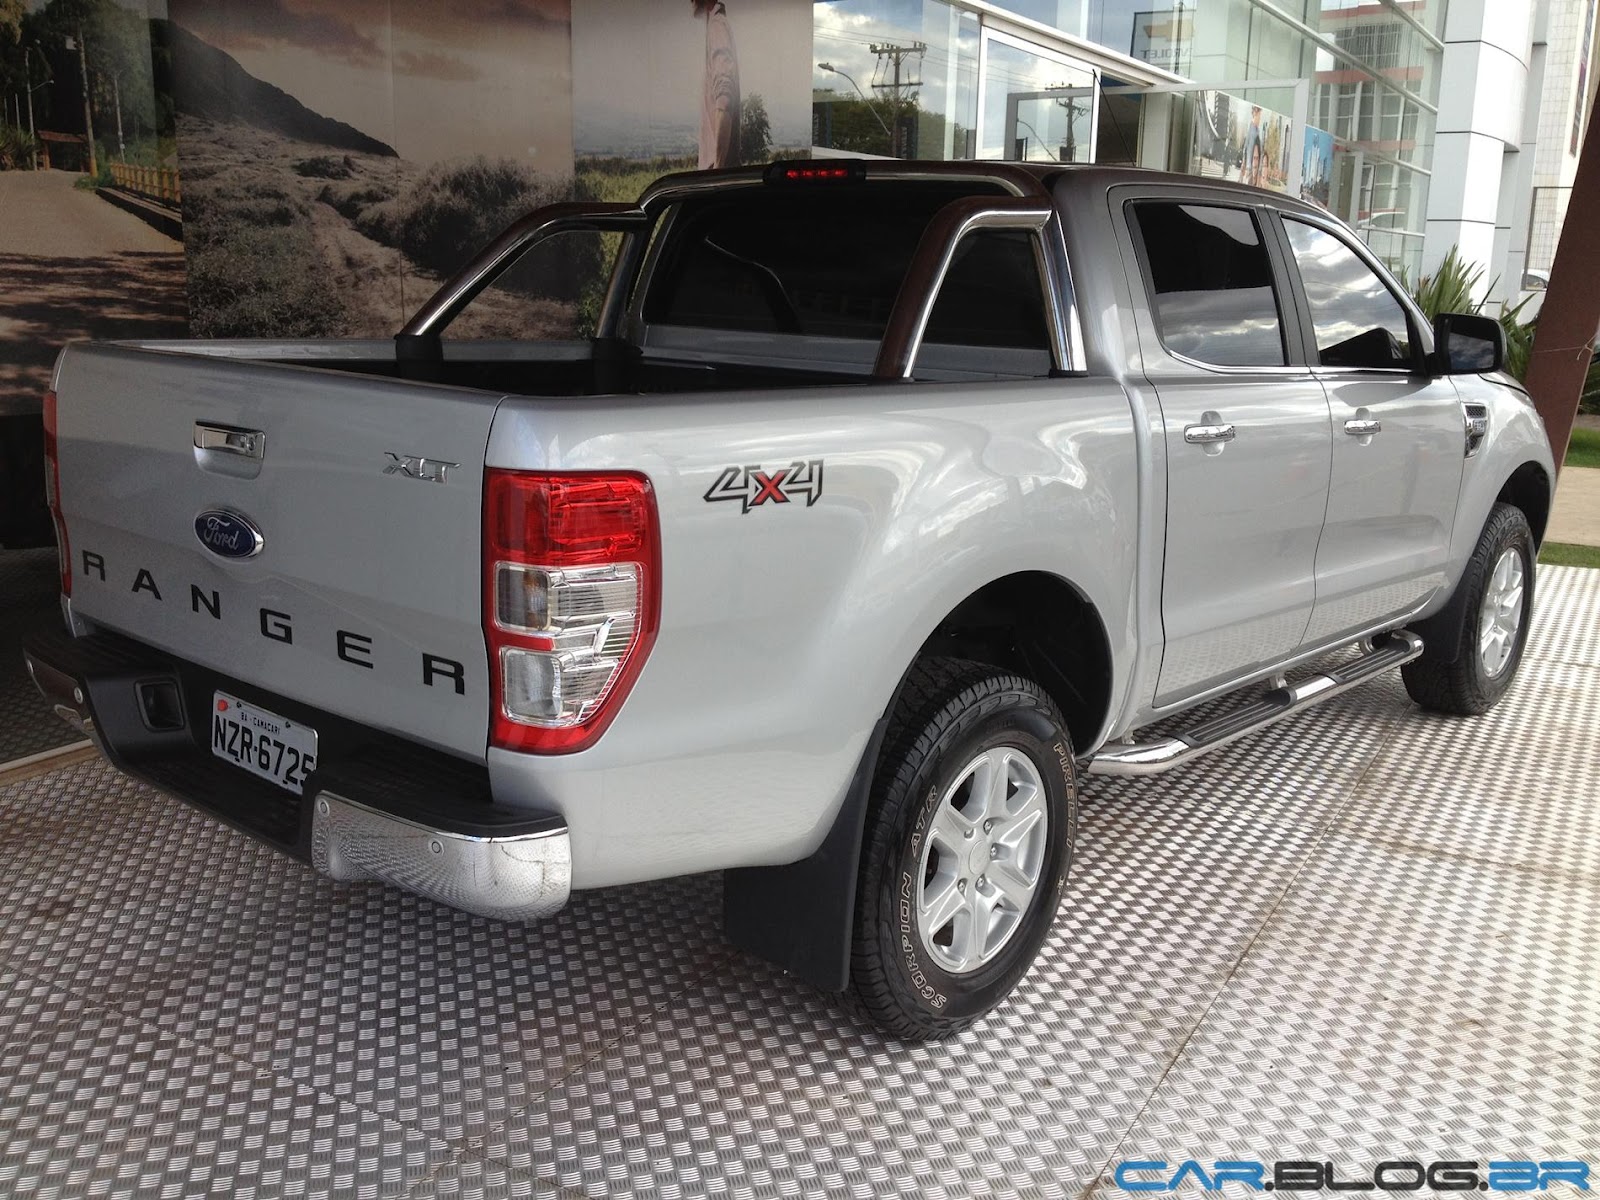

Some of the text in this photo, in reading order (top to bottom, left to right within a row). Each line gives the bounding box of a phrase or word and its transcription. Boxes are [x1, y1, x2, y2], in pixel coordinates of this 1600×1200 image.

[383, 452, 460, 485] XLT
[204, 516, 240, 550] Ford
[82, 550, 465, 695] RANGER
[1053, 742, 1075, 849] PIRELLI
[899, 784, 947, 1009] SCORPION ATR
